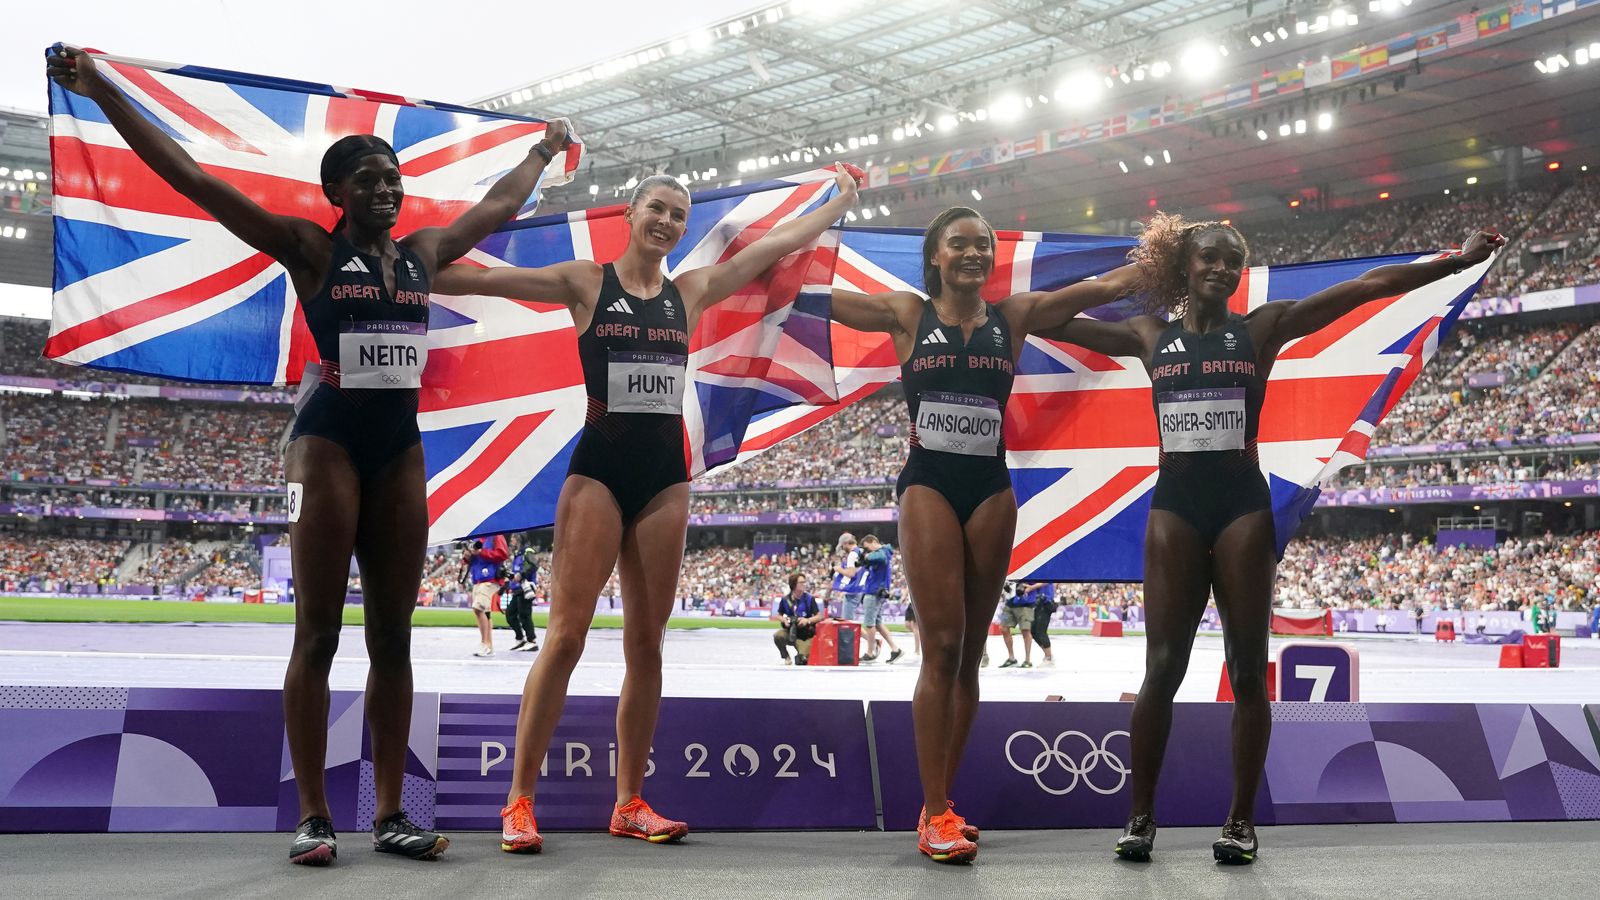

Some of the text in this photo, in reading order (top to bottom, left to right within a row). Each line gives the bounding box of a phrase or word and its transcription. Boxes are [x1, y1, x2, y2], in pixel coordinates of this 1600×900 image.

[331, 284, 381, 301] GREAT
[367, 323, 389, 331] PARIS
[596, 323, 641, 339] GREAT
[360, 345, 417, 367] NEITA
[913, 355, 957, 372] GREAT
[1152, 360, 1256, 381] GREAT BRITAIN
[628, 374, 676, 395] HUNT
[940, 394, 983, 404] PARIS 2024
[919, 412, 1000, 437] LANSIQUOT
[1162, 410, 1244, 433] ASHER-SMITH
[290, 490, 296, 514] 8
[1295, 665, 1336, 702] 7
[684, 742, 836, 778] 2024
